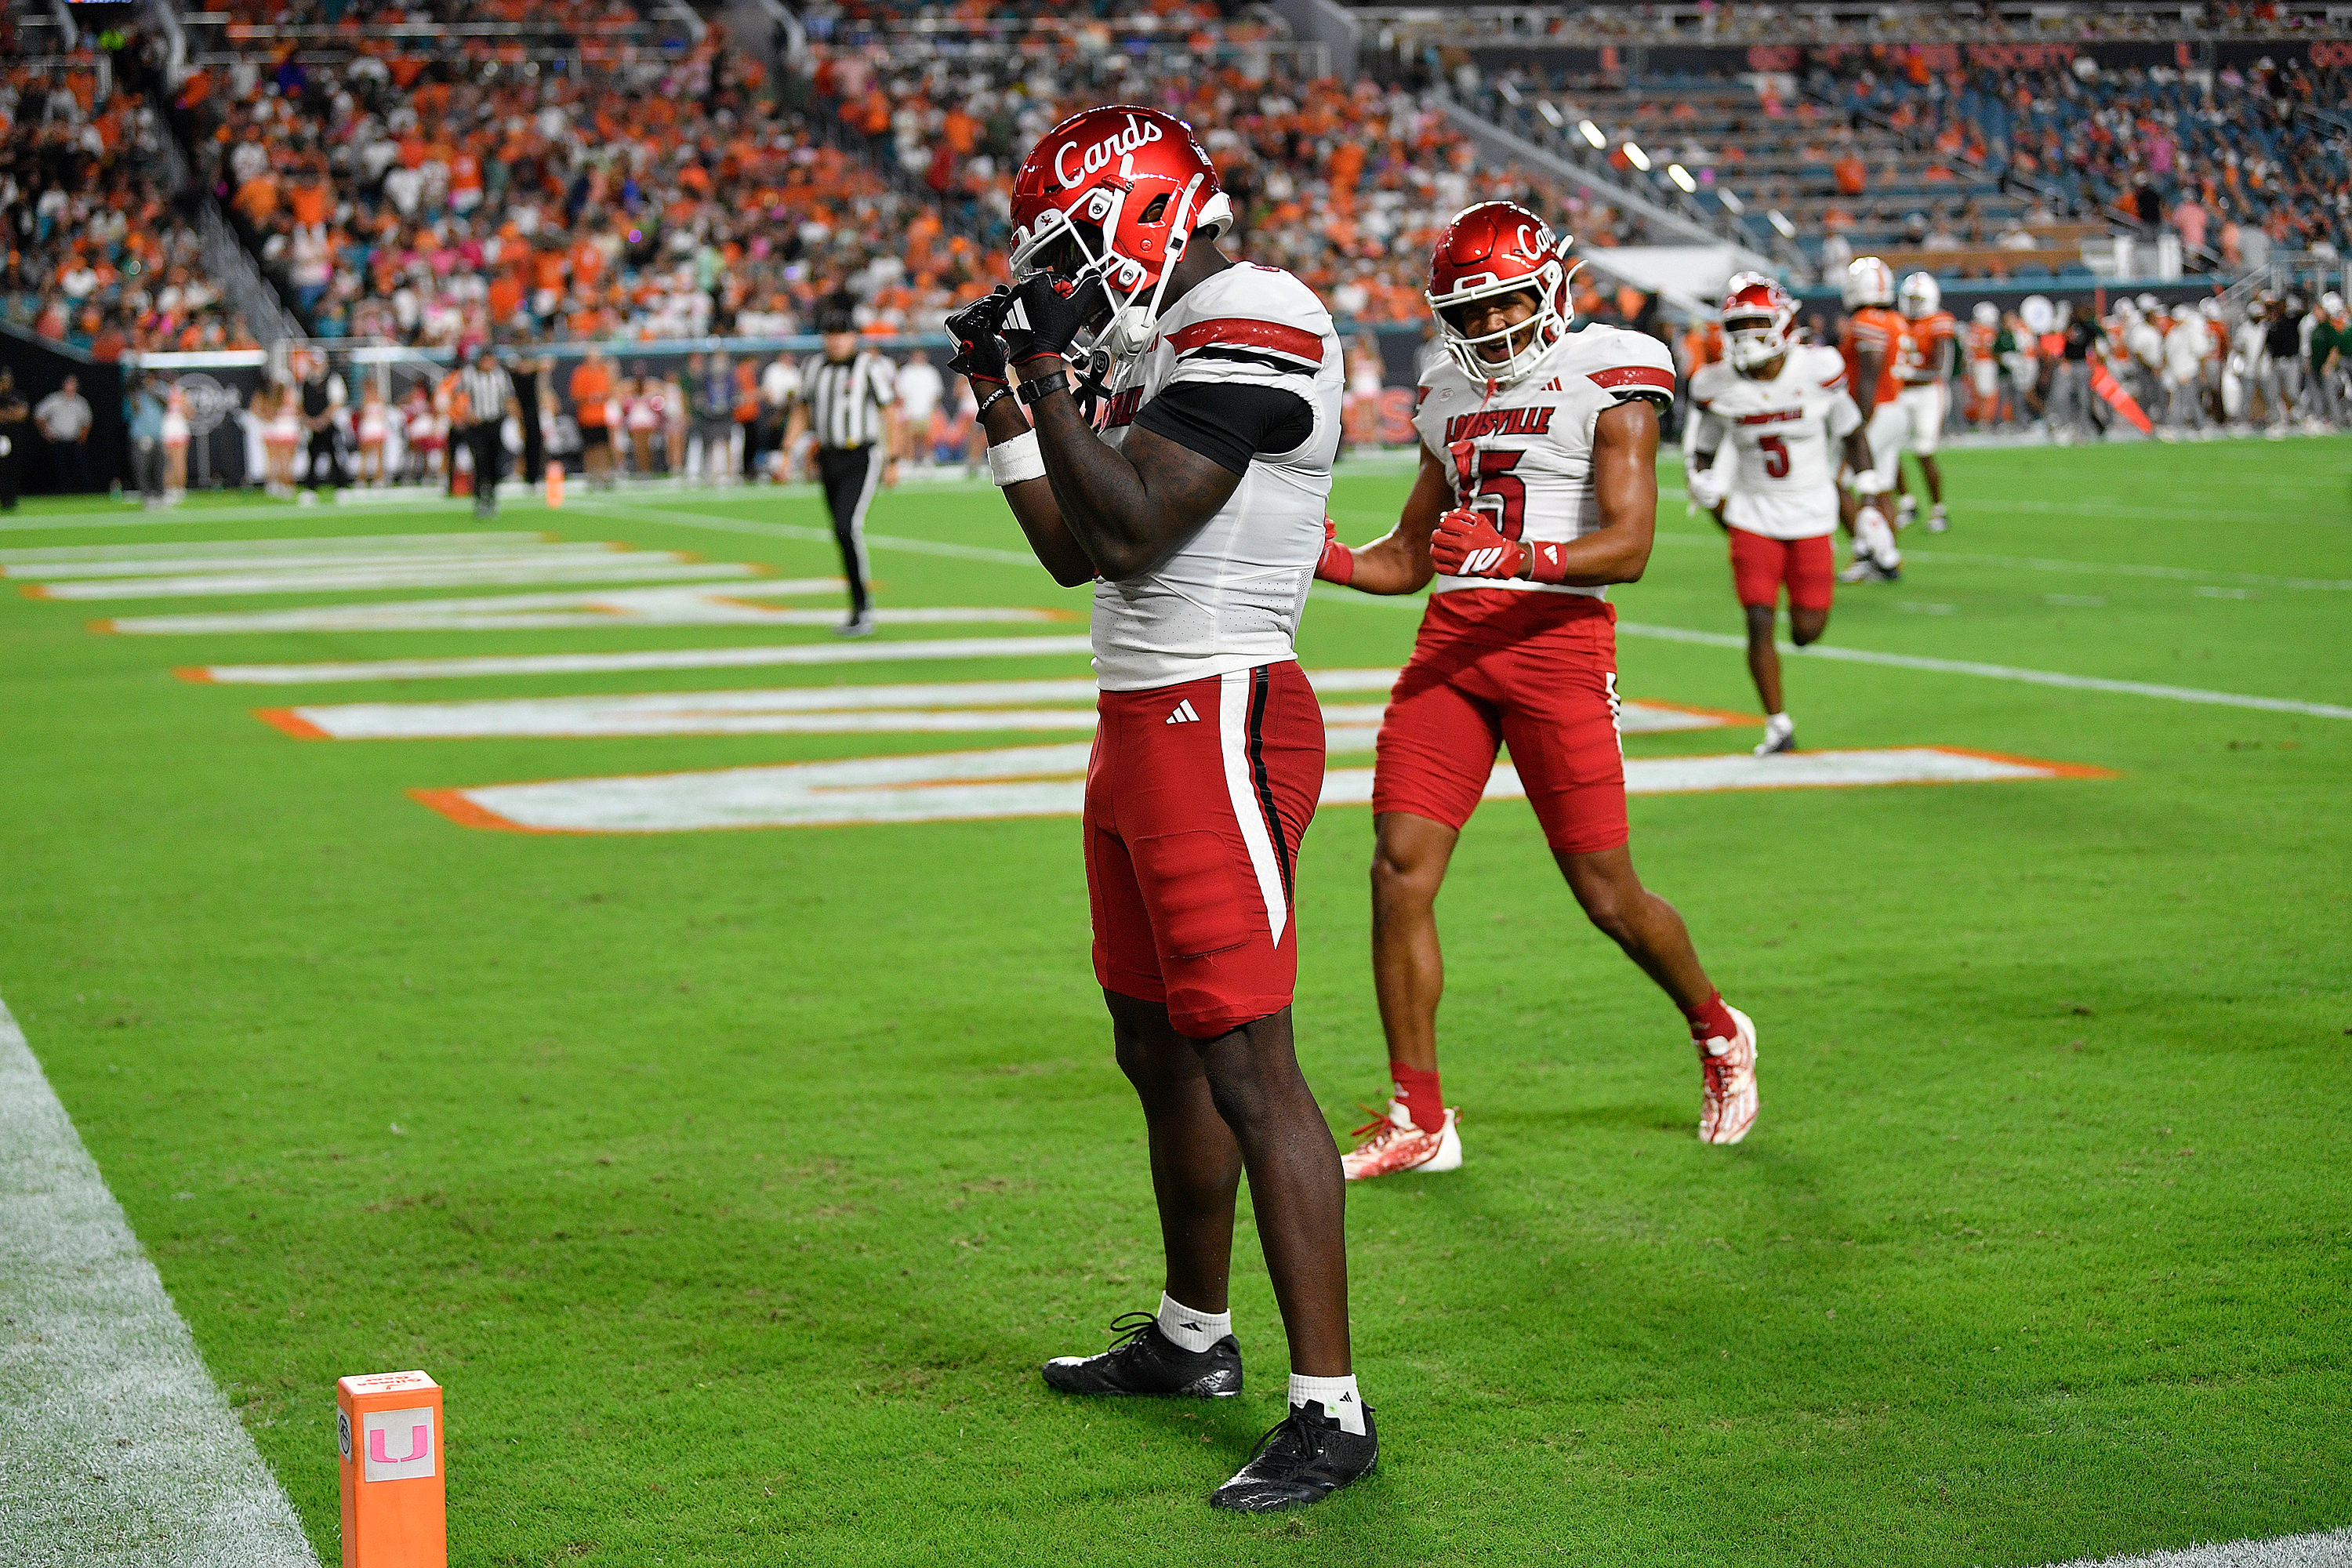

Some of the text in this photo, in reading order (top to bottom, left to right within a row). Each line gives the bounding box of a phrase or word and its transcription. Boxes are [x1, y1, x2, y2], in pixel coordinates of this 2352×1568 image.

[1054, 113, 1163, 190] Cards
[1443, 406, 1556, 448] LOUISVILLE
[369, 1425, 428, 1463] U
